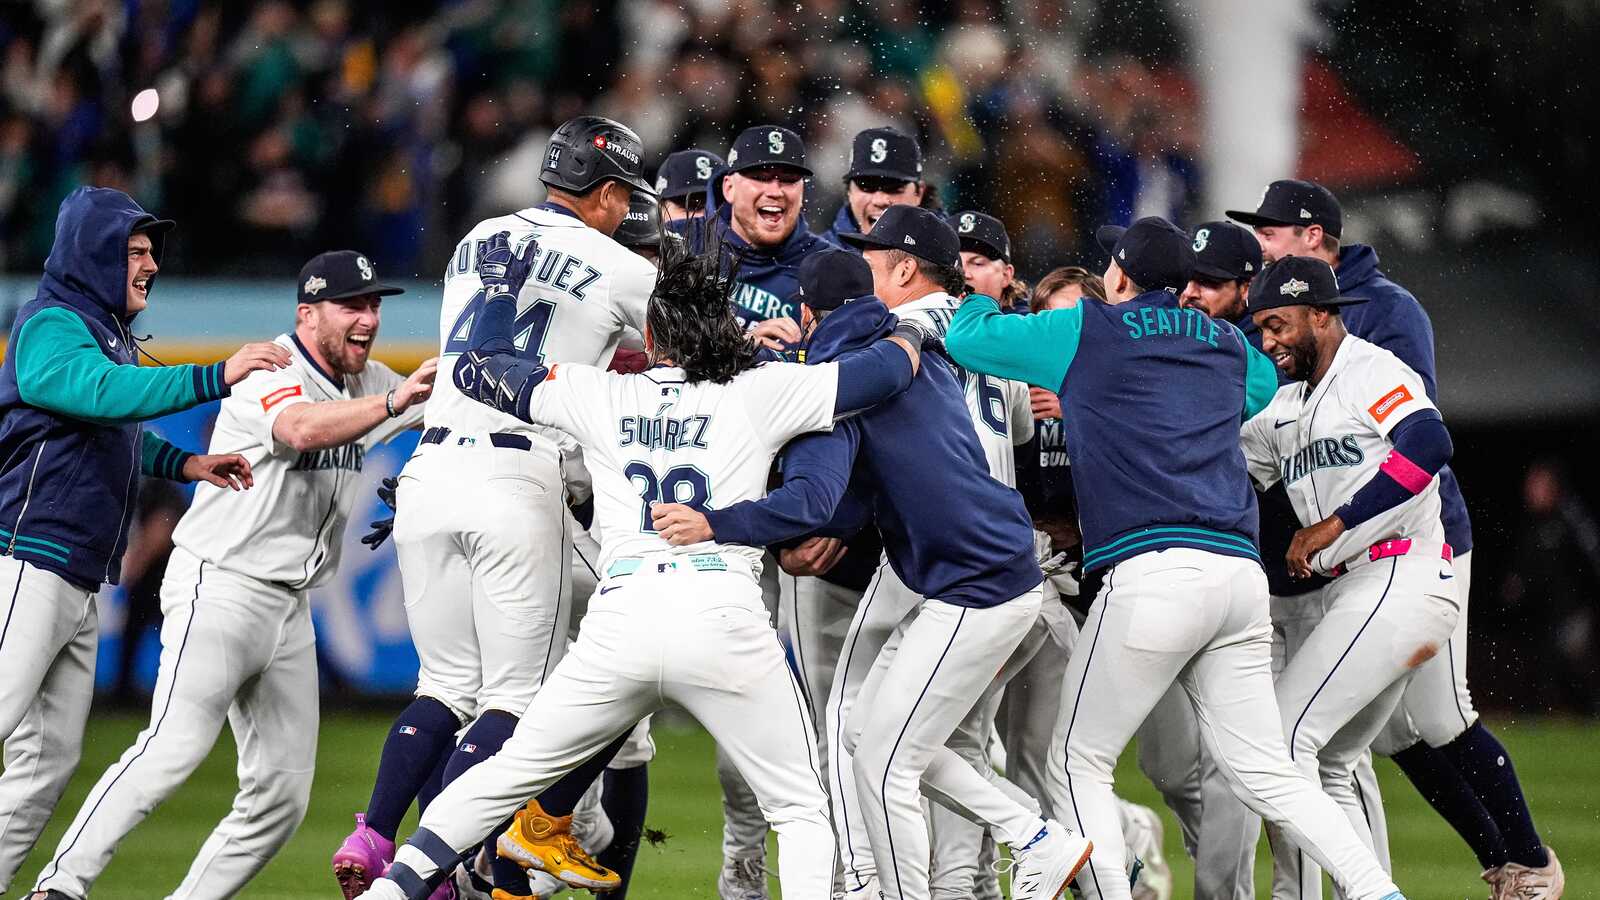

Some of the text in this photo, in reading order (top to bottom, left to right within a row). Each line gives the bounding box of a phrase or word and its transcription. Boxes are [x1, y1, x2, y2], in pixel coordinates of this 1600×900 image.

[606, 141, 639, 164] STRAUSS
[624, 212, 649, 221] AUSS
[1122, 306, 1220, 349] SEATTLE
[620, 402, 712, 452] SUÁREZ
